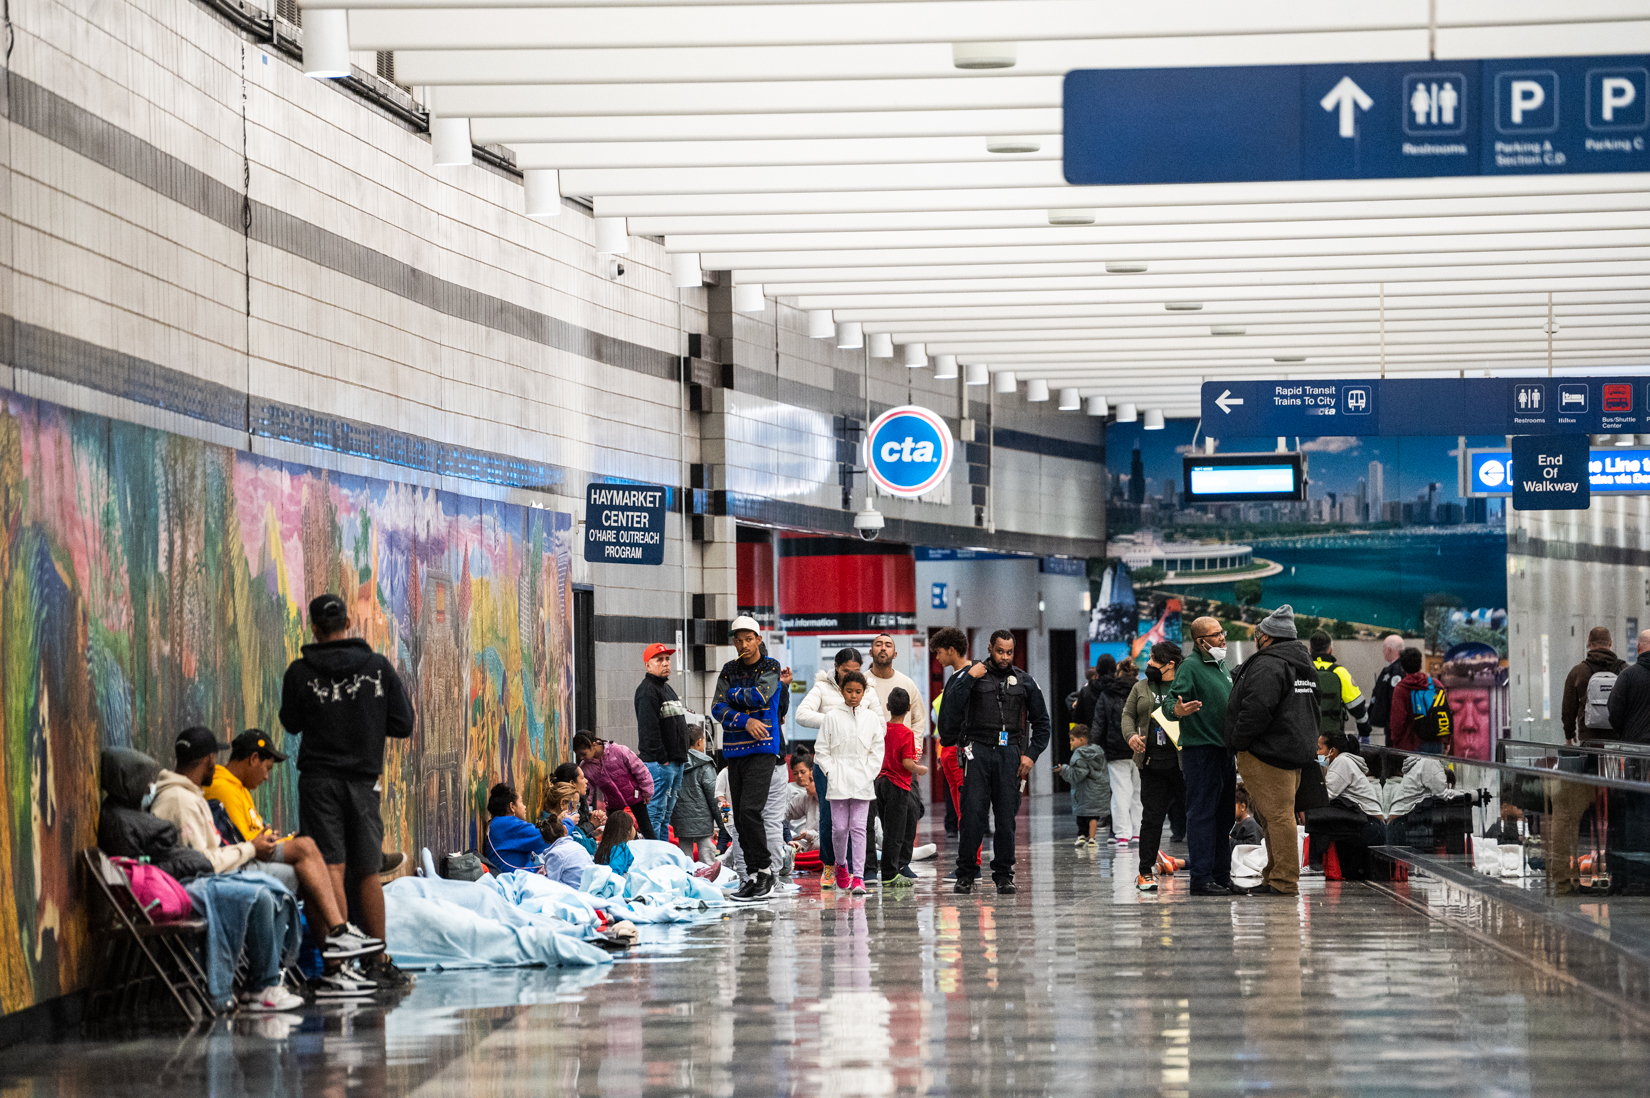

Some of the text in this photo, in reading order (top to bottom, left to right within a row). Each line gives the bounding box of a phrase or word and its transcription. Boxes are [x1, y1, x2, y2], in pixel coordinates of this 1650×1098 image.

[1511, 80, 1545, 124] P
[1603, 77, 1636, 121] P
[1402, 142, 1468, 155] Restrooms
[1495, 141, 1541, 153] Parking
[1585, 138, 1631, 152] Parking
[1275, 386, 1336, 396] Rapid Transit
[1273, 397, 1336, 406] Trains To City
[1319, 407, 1336, 415] cta
[1538, 454, 1563, 465] End
[1605, 457, 1641, 472] Line
[1543, 467, 1559, 478] Of
[1523, 481, 1579, 493] Walkway
[590, 488, 662, 508] HAYMARKET
[601, 510, 649, 528] CENTER
[588, 529, 660, 544] O'HARE OUTREACH
[604, 546, 642, 559] PROGRAM
